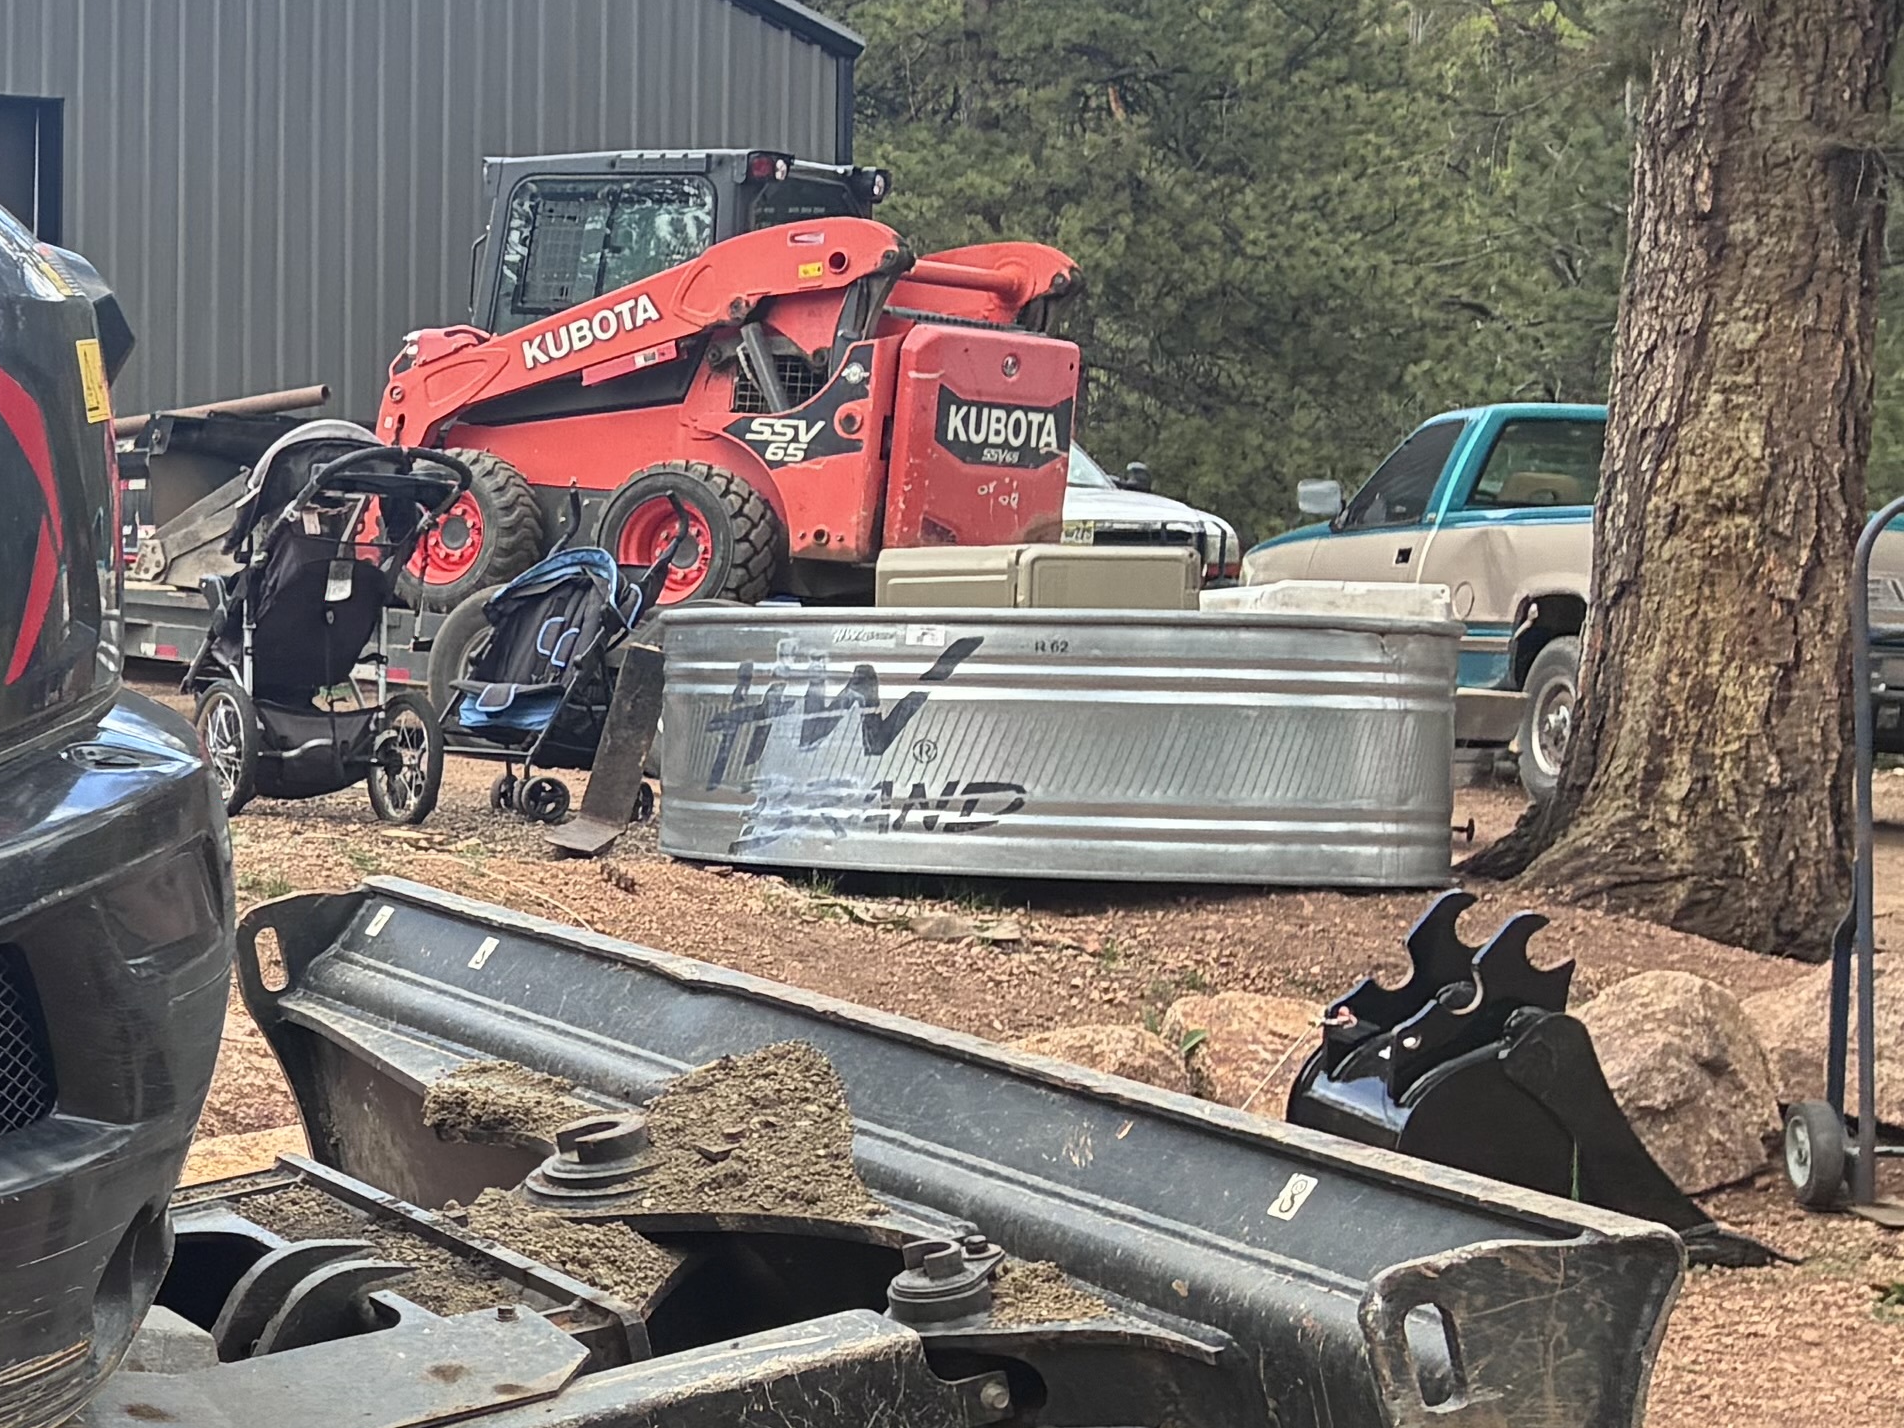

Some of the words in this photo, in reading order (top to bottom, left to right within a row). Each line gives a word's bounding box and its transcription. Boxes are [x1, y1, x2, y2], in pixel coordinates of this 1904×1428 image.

[522, 294, 660, 369] KUBOTA
[745, 417, 826, 443] SSV
[947, 404, 1057, 449] KUBOTA
[764, 442, 808, 462] 65
